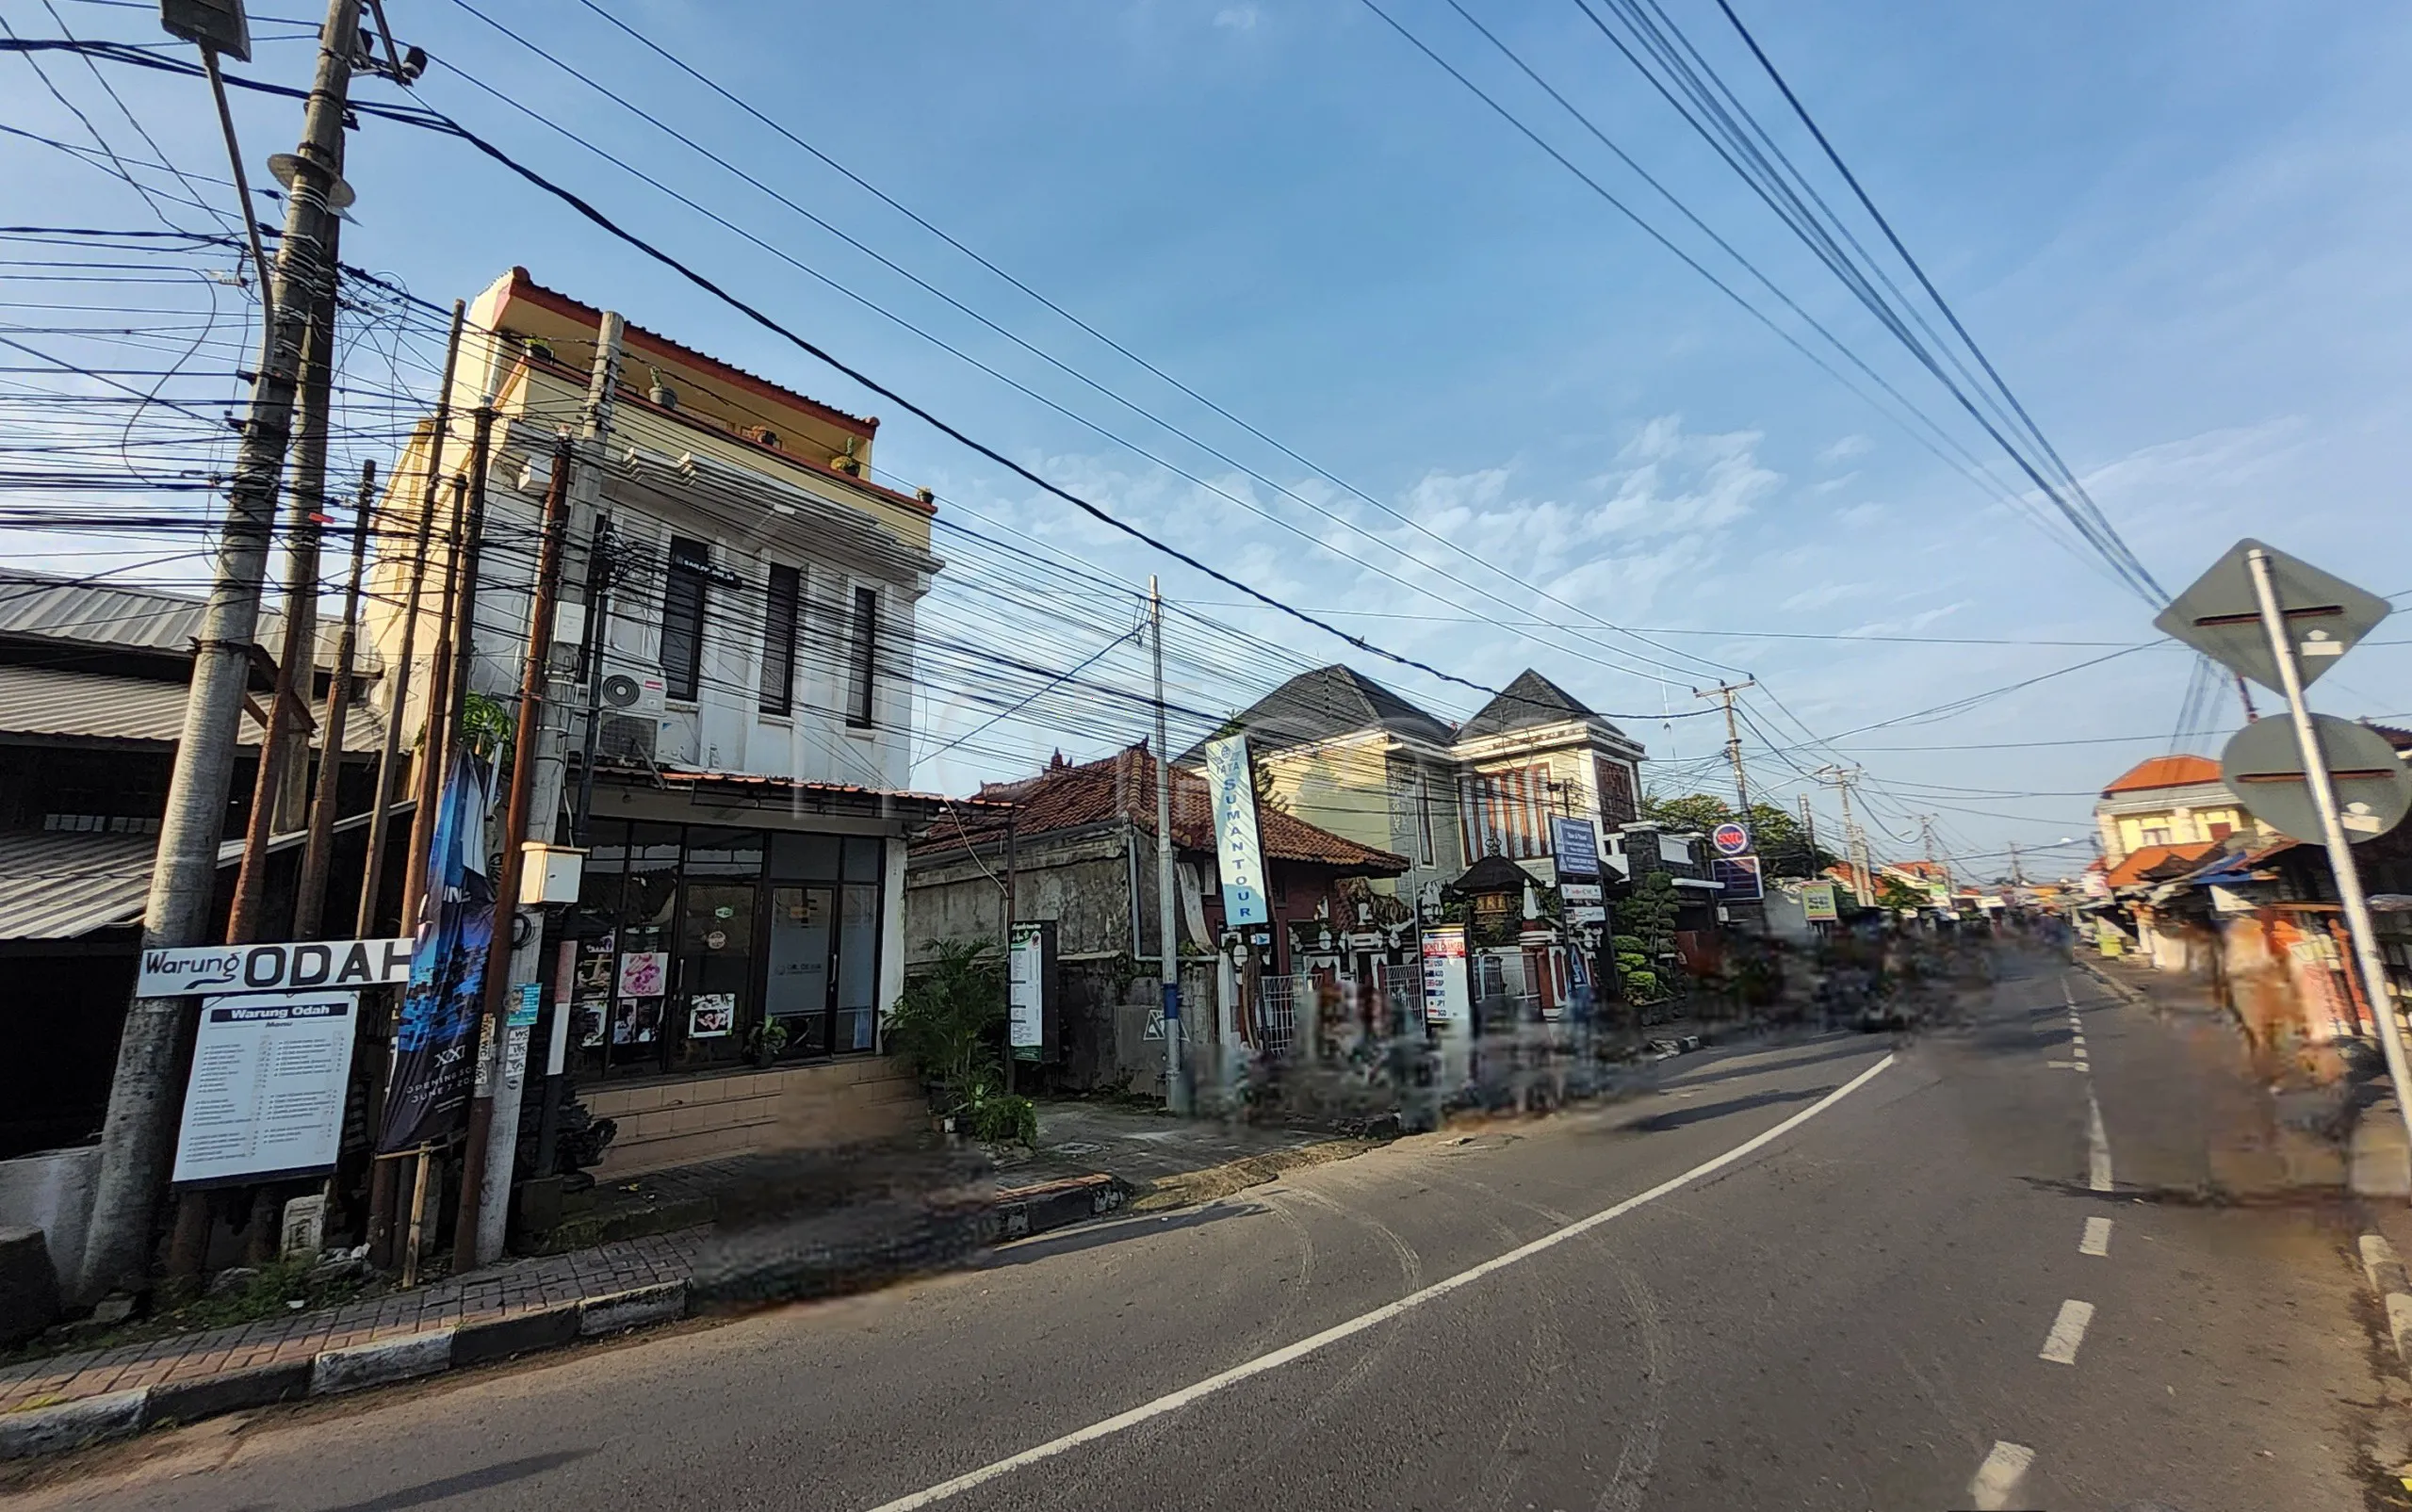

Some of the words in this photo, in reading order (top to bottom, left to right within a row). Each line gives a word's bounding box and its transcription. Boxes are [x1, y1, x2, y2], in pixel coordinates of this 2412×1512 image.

[146, 951, 240, 990] Warung
[243, 941, 413, 988] ODAH
[231, 1007, 288, 1019] Warung
[291, 1004, 331, 1016] Odah
